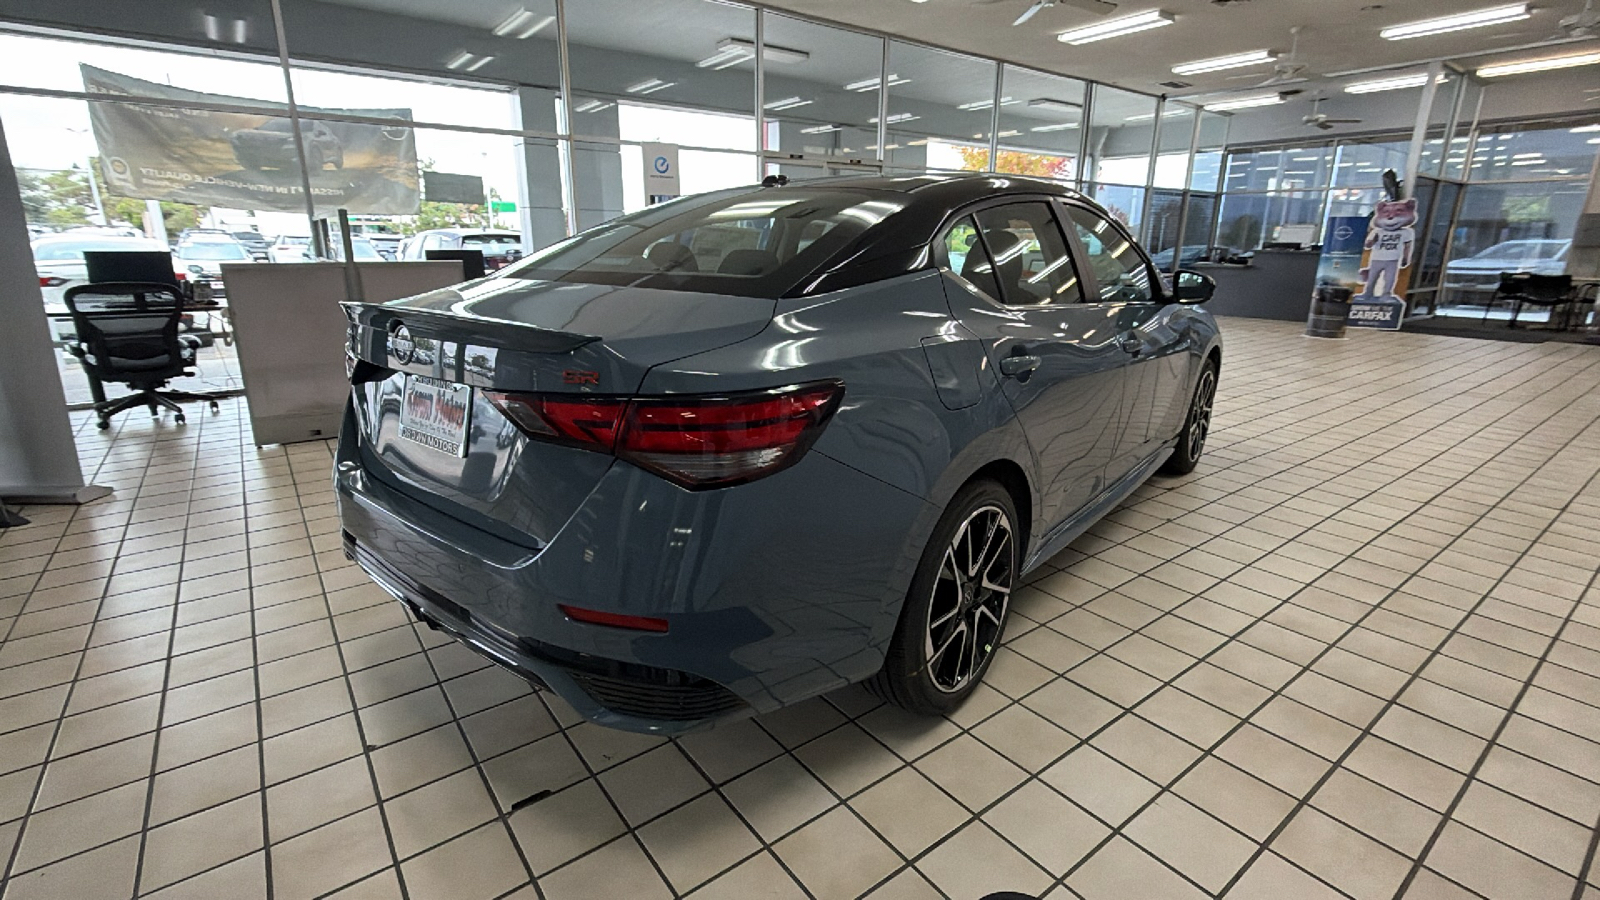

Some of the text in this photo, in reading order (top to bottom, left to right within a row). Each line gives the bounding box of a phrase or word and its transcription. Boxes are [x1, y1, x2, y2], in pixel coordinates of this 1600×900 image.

[1380, 234, 1402, 243] CAR
[1379, 243, 1399, 251] FOX
[1348, 311, 1393, 321] CARFAX
[562, 369, 600, 385] SR
[427, 434, 459, 454] MOTORS
